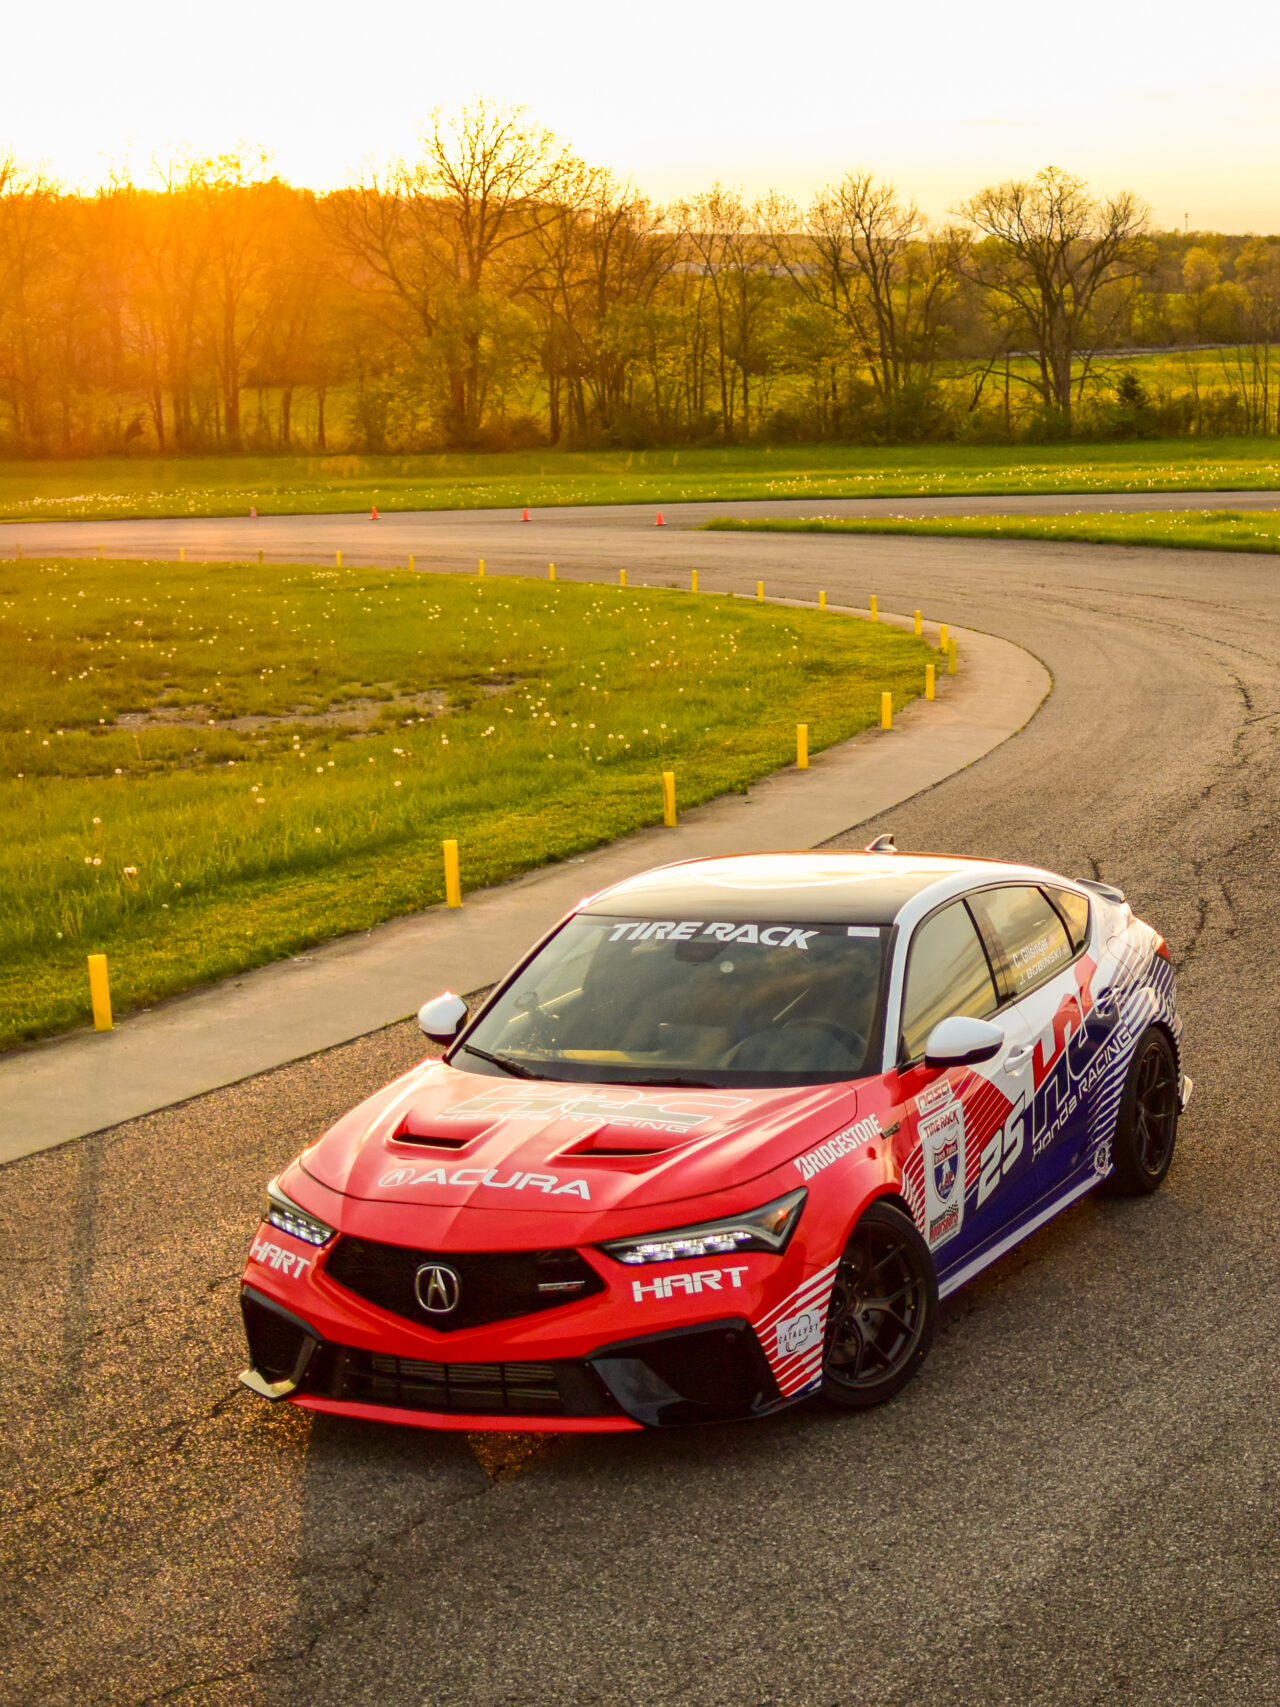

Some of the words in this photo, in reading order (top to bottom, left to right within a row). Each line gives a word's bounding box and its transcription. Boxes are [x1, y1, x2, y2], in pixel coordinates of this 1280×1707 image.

[609, 921, 704, 941] TIRE
[703, 922, 819, 949] RACK
[1032, 1098, 1077, 1162] Honda
[1078, 1021, 1132, 1099] RACING
[559, 1113, 692, 1134] RACING
[793, 1113, 882, 1181] BRIDGESTONE
[976, 1091, 1025, 1210] 25
[409, 1168, 591, 1200] ACURA
[249, 1237, 311, 1279] HART
[632, 1266, 749, 1302] HART
[778, 1322, 819, 1345] CATALYST
